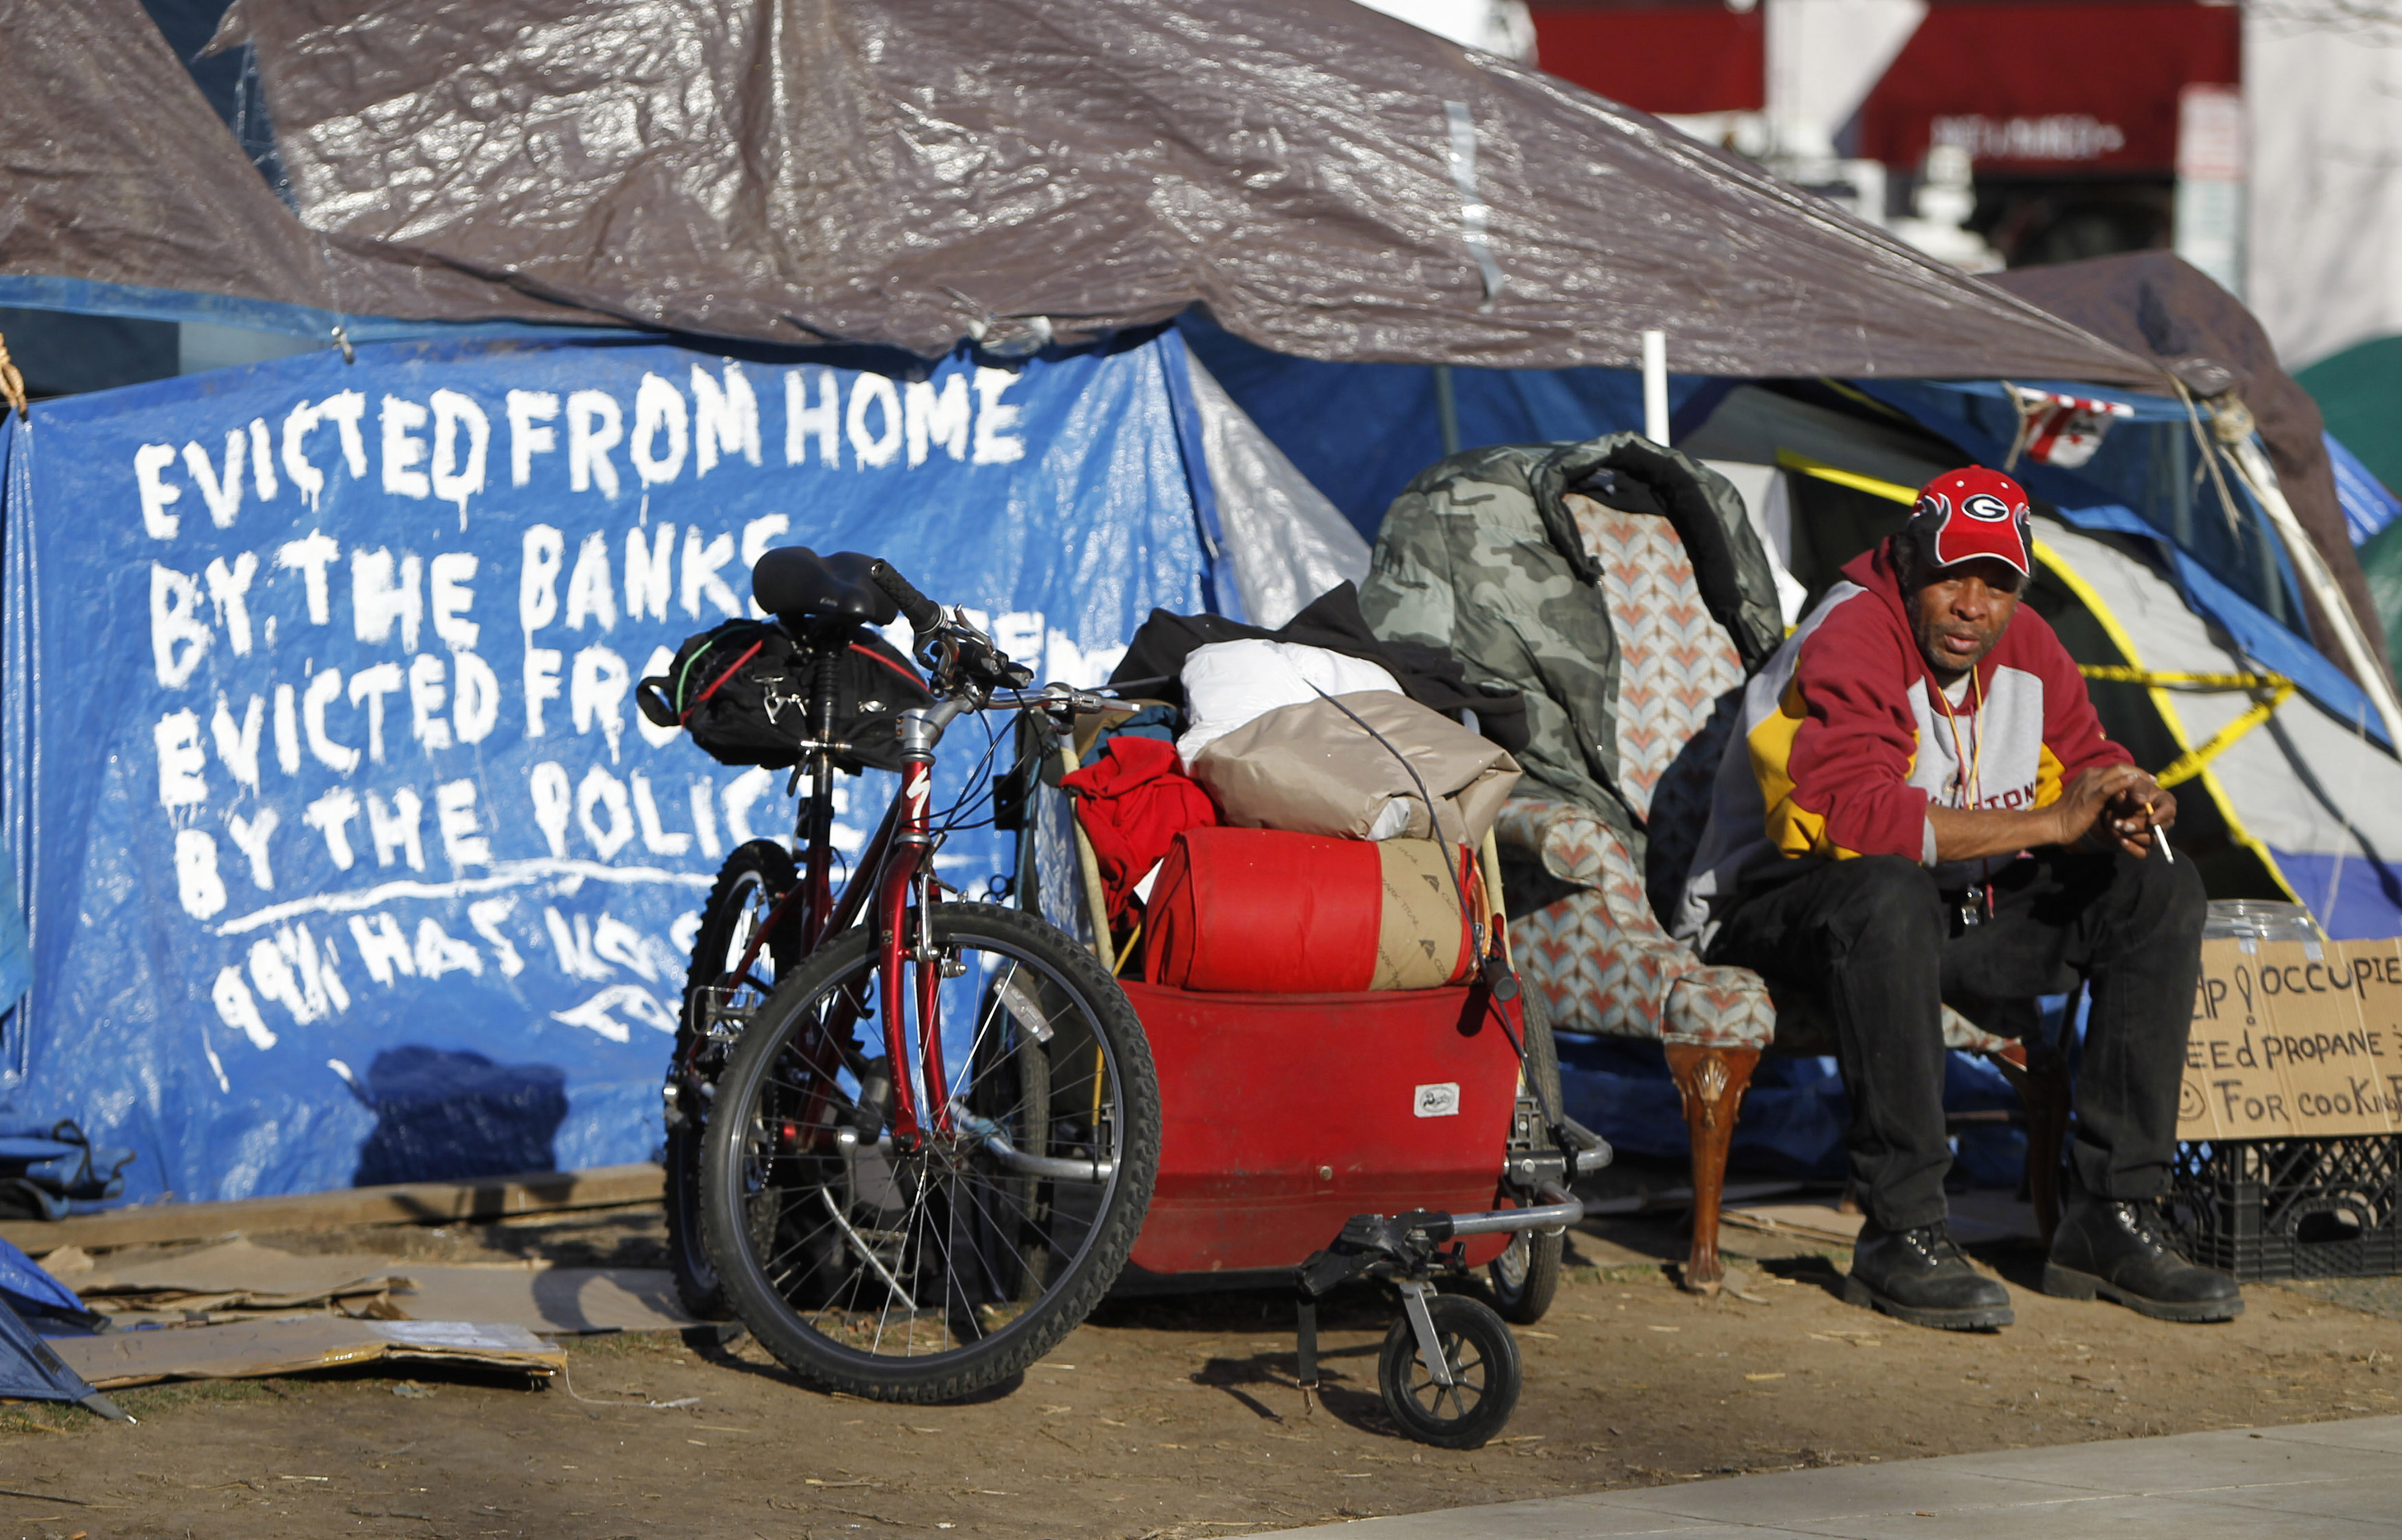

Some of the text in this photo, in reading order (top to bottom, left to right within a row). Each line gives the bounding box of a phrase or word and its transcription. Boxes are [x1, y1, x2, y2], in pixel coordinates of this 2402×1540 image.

[136, 358, 1025, 541] EVICTED FROM HOME
[1968, 495, 2008, 519] G
[151, 559, 259, 689] BY
[276, 528, 480, 653] THE
[154, 652, 499, 811] EVICTED
[523, 645, 684, 760] FRO
[174, 760, 867, 920] BY THE POLICE
[2262, 1028, 2385, 1070] PROPANE
